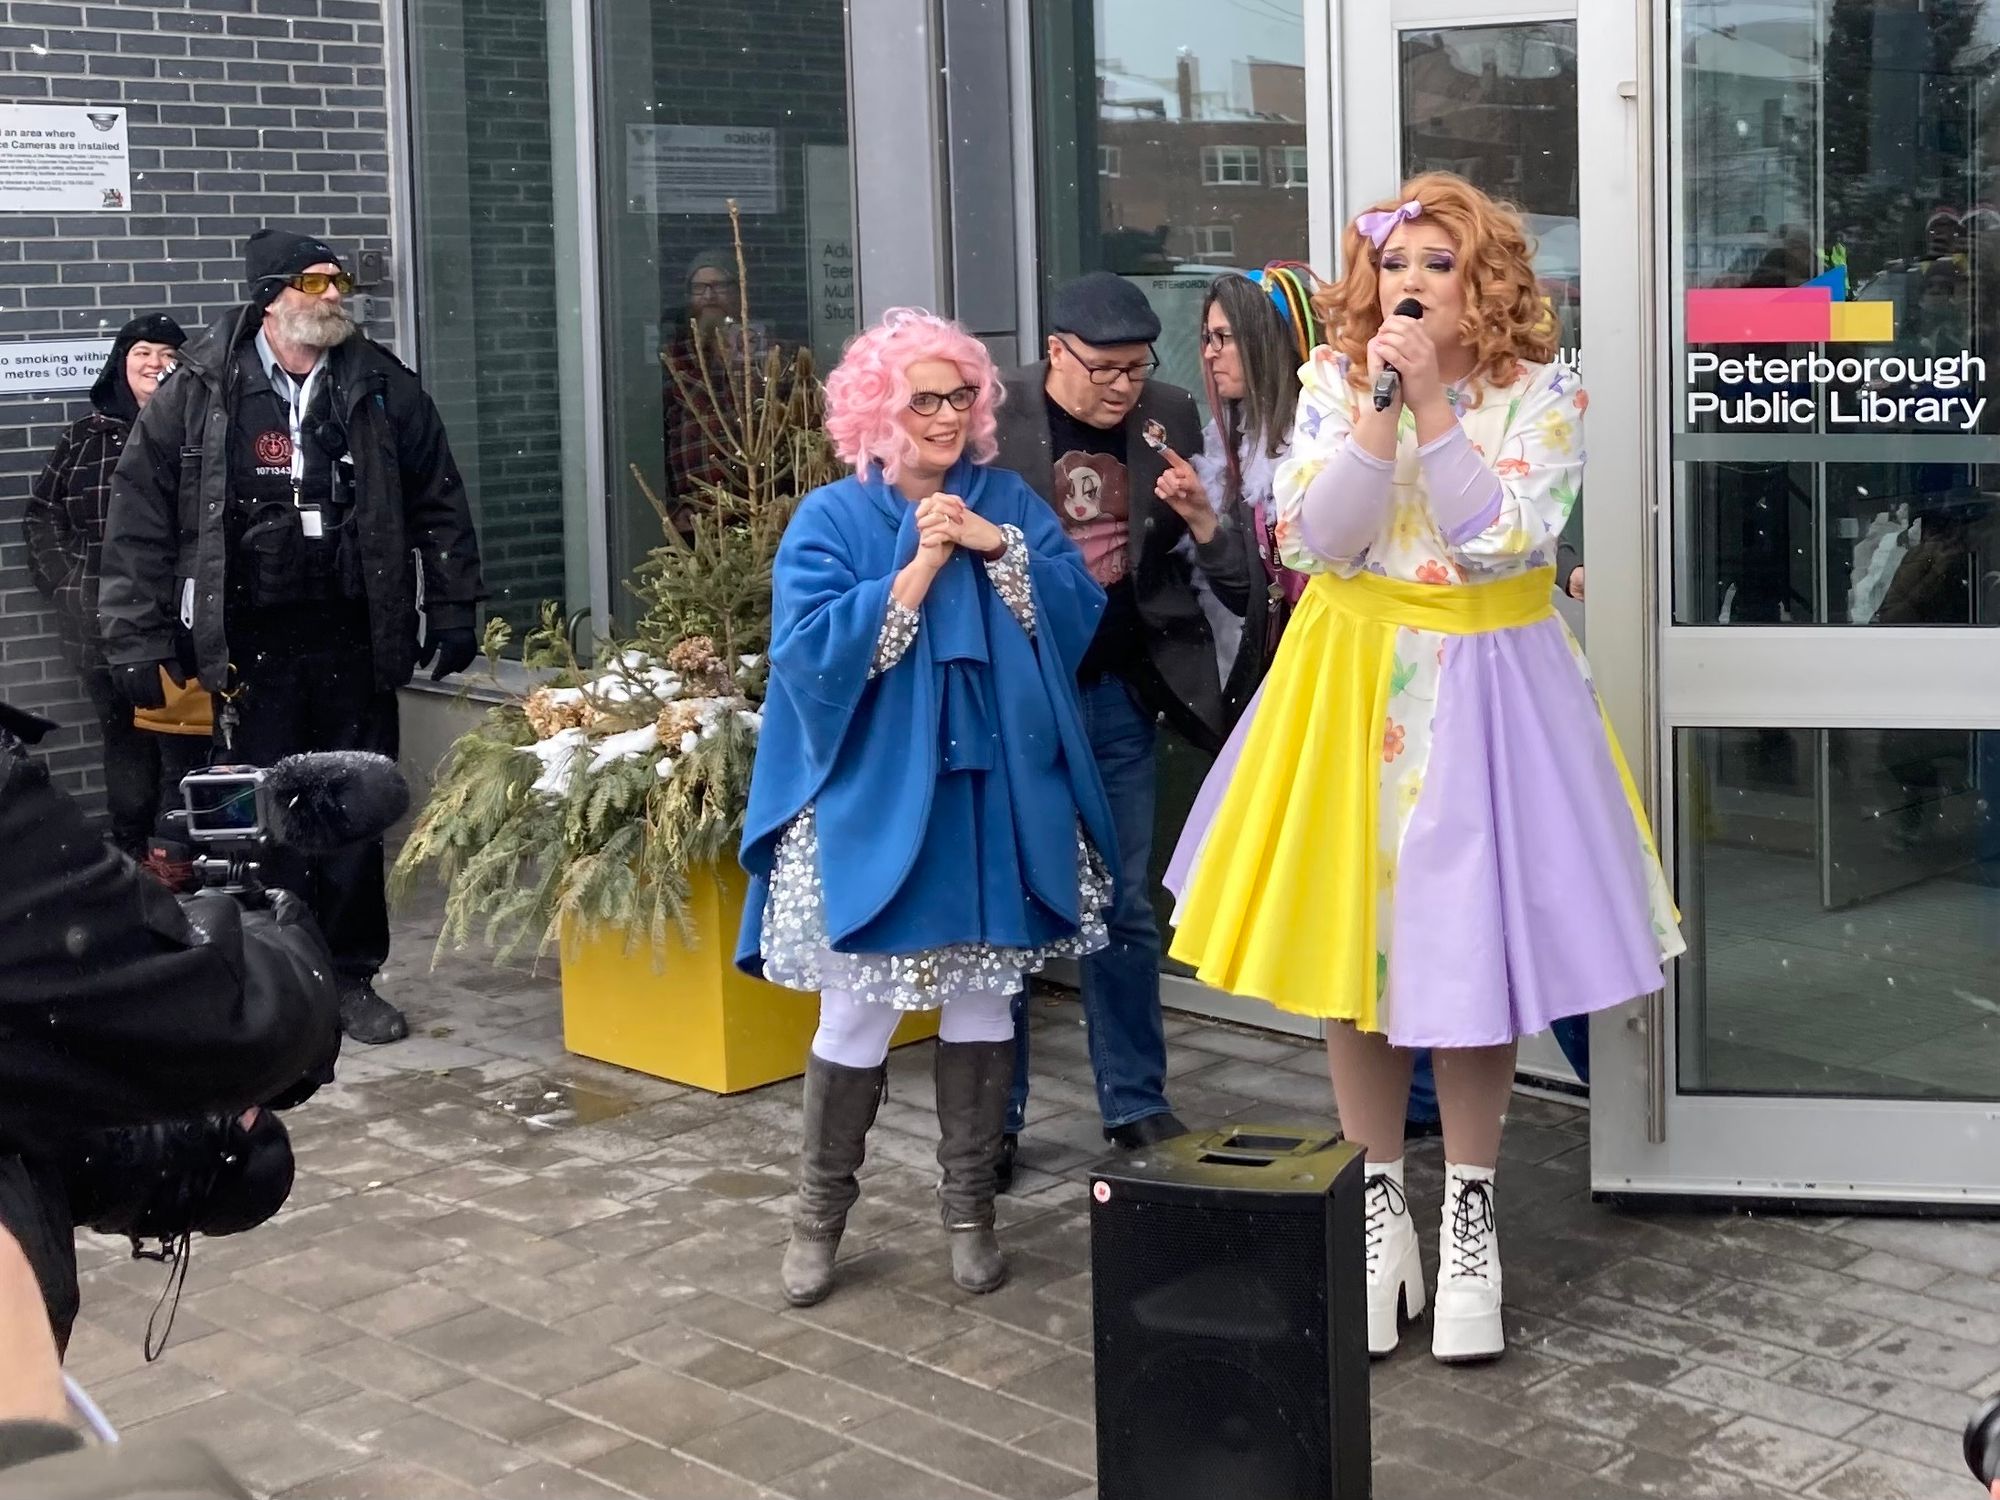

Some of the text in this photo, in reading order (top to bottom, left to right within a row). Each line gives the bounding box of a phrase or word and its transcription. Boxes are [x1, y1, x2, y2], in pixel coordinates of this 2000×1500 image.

[45, 130, 76, 138] where
[11, 140, 56, 150] Cameras
[78, 142, 120, 151] installed
[824, 284, 854, 298] Mul
[1152, 280, 1208, 289] PETERBOROU
[0, 357, 8, 365] o
[15, 353, 69, 365] smoking
[5, 365, 103, 379] metres (30 fee
[1687, 350, 1986, 389] Peterborough
[1687, 391, 1987, 429] Public Library
